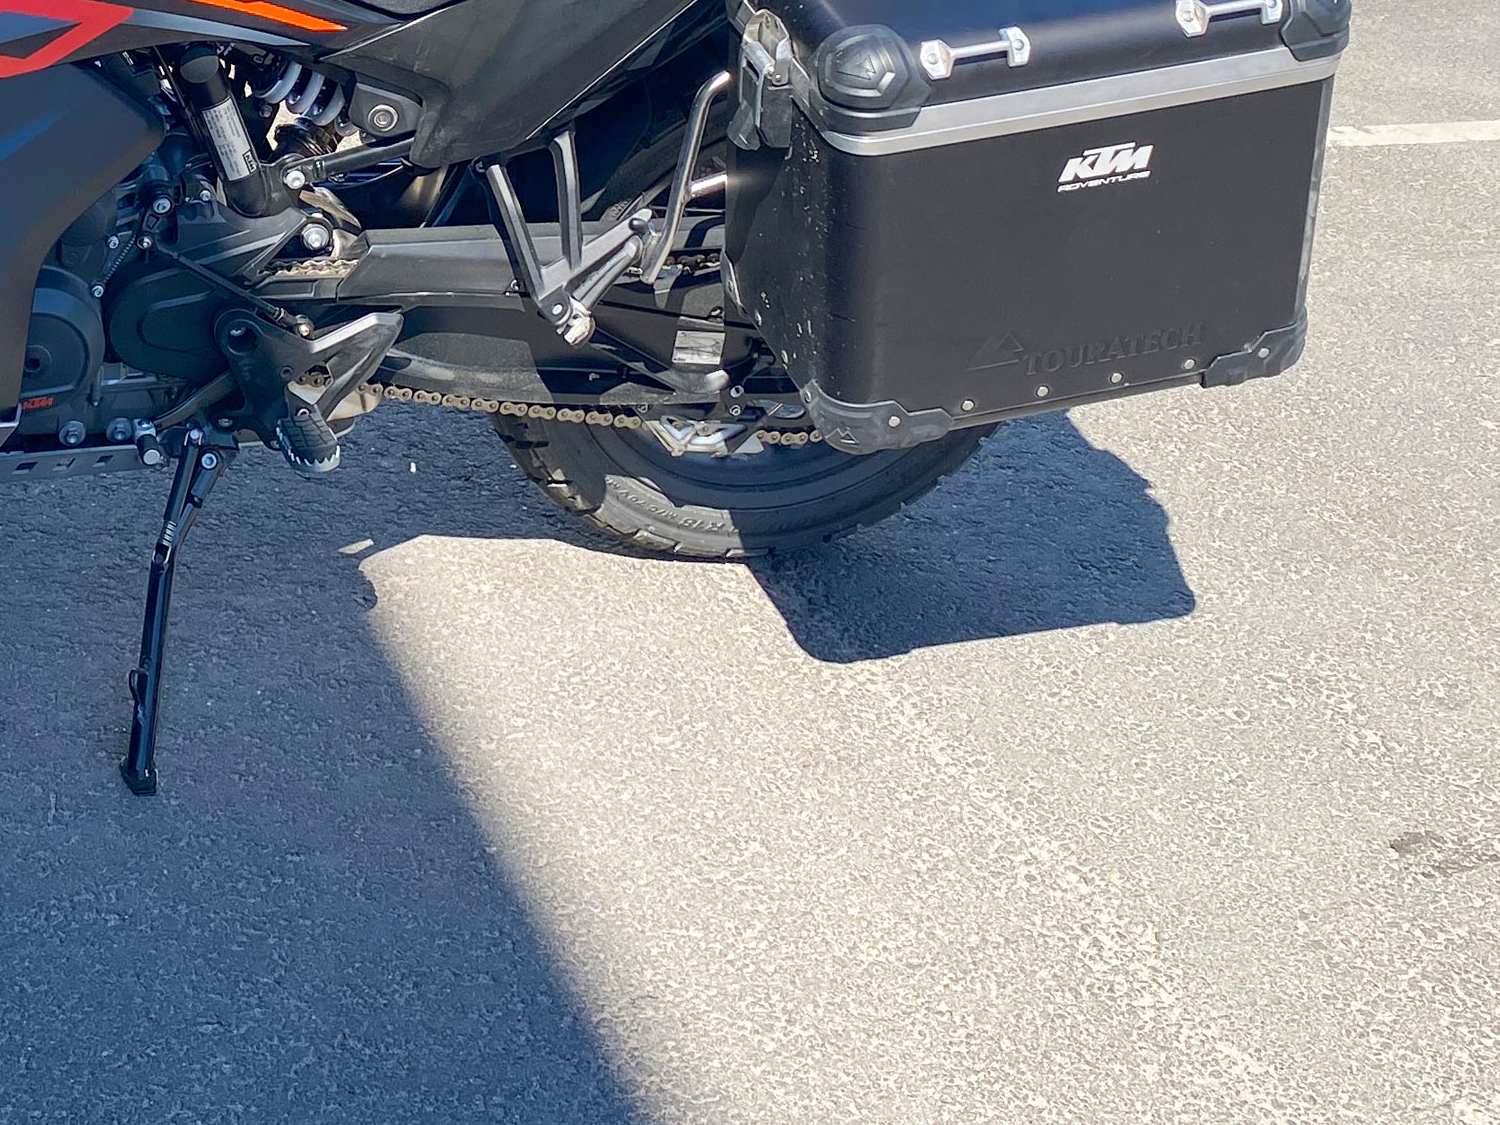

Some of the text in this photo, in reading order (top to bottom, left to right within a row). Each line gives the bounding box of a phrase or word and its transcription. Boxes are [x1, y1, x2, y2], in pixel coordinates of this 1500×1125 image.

[1057, 170, 1151, 193] ADVENTURE
[1058, 141, 1154, 183] KTM
[1022, 322, 1203, 376] TOURATECH
